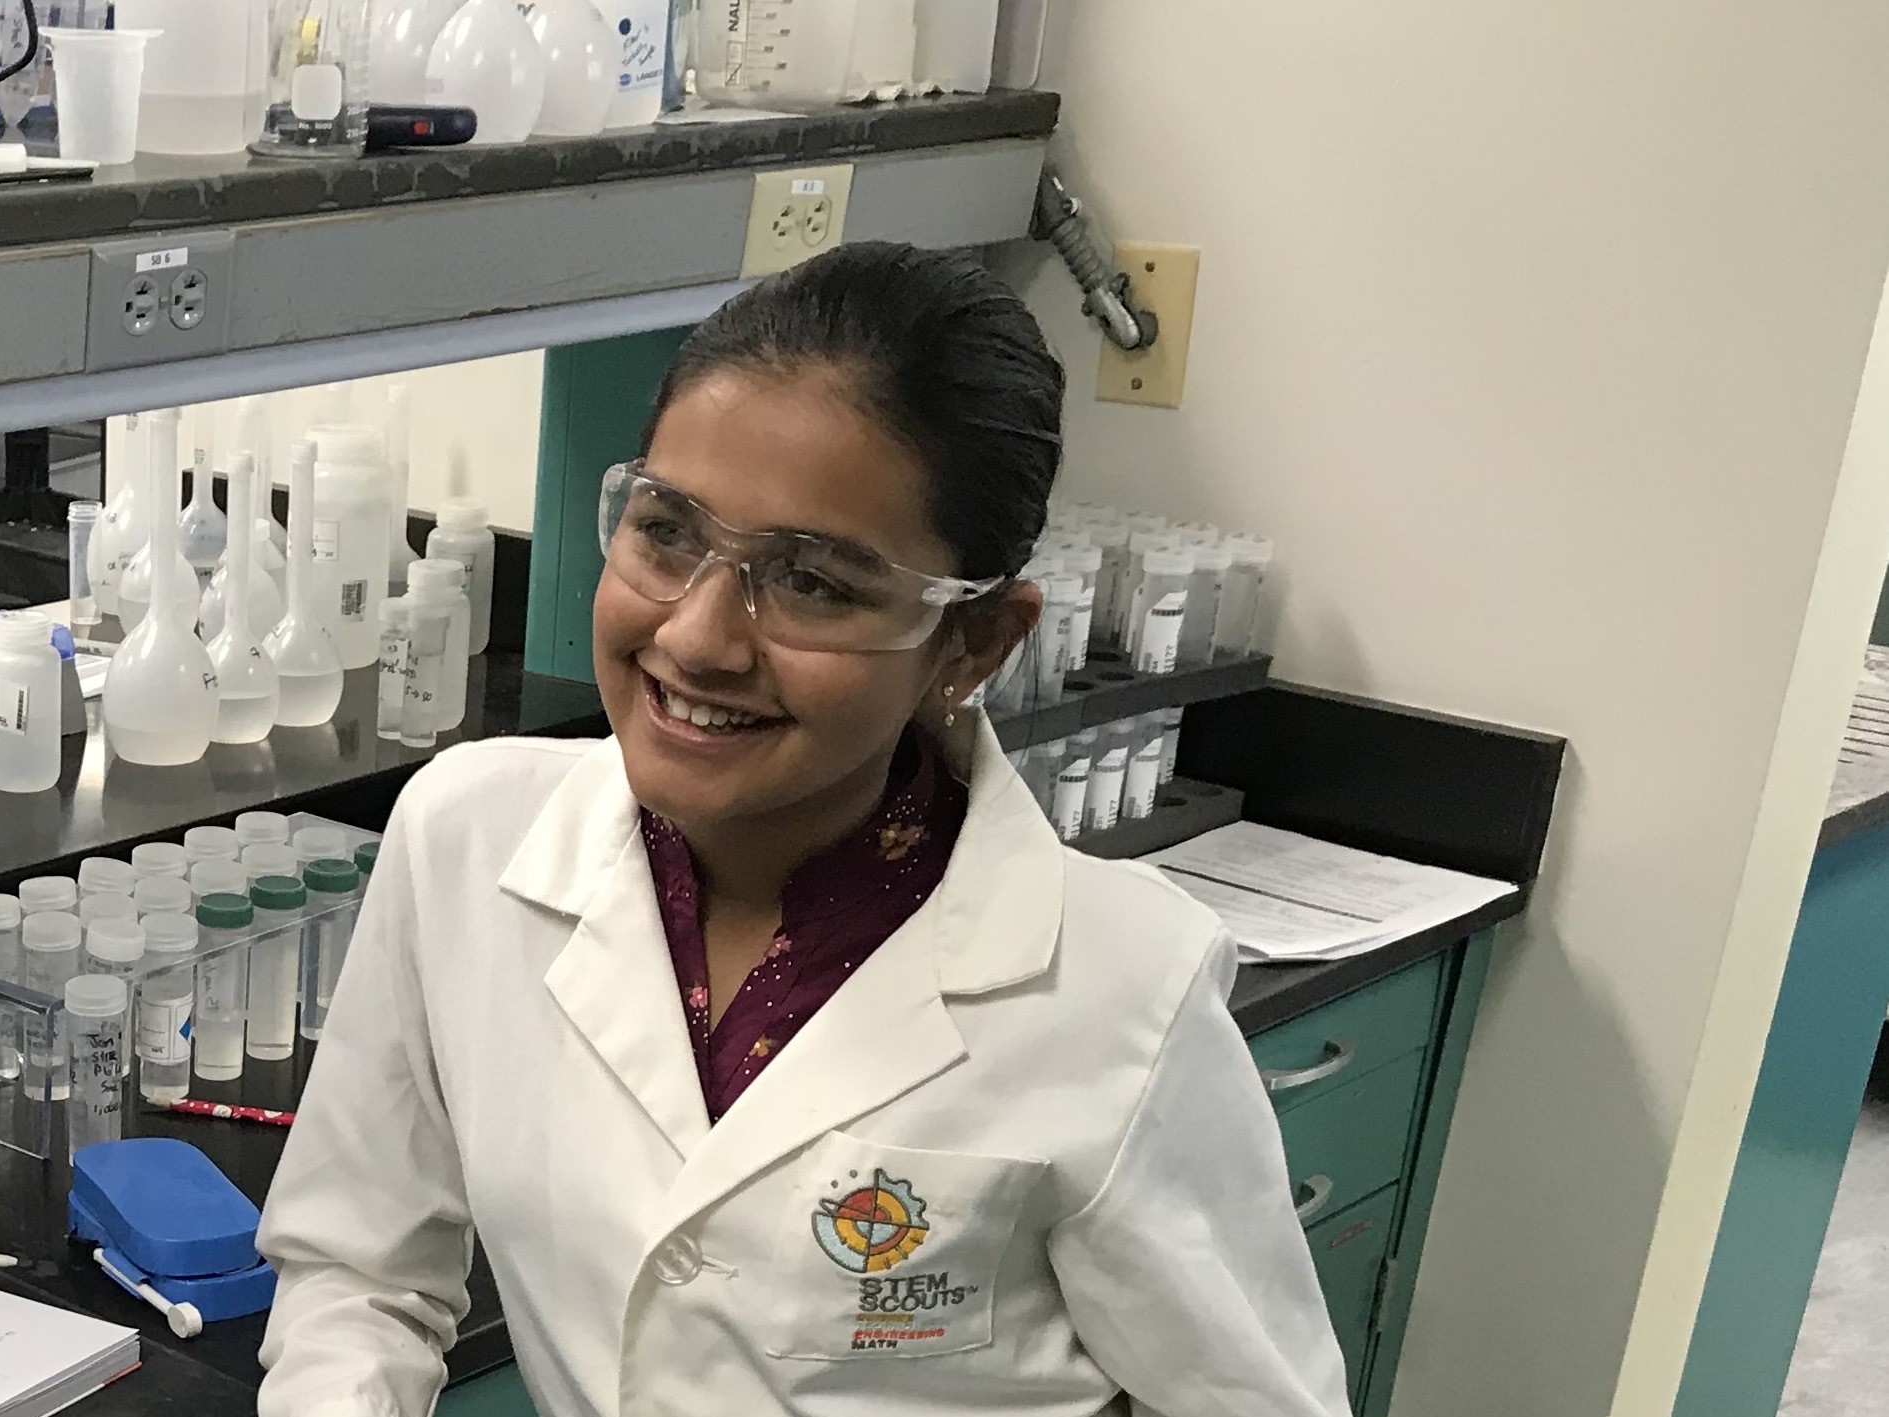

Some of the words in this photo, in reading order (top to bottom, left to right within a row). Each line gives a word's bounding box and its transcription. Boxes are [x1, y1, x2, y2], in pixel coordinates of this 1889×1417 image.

[859, 1272, 949, 1297] STEM
[859, 1287, 965, 1312] SCOUTS
[851, 1339, 898, 1350] MATH
